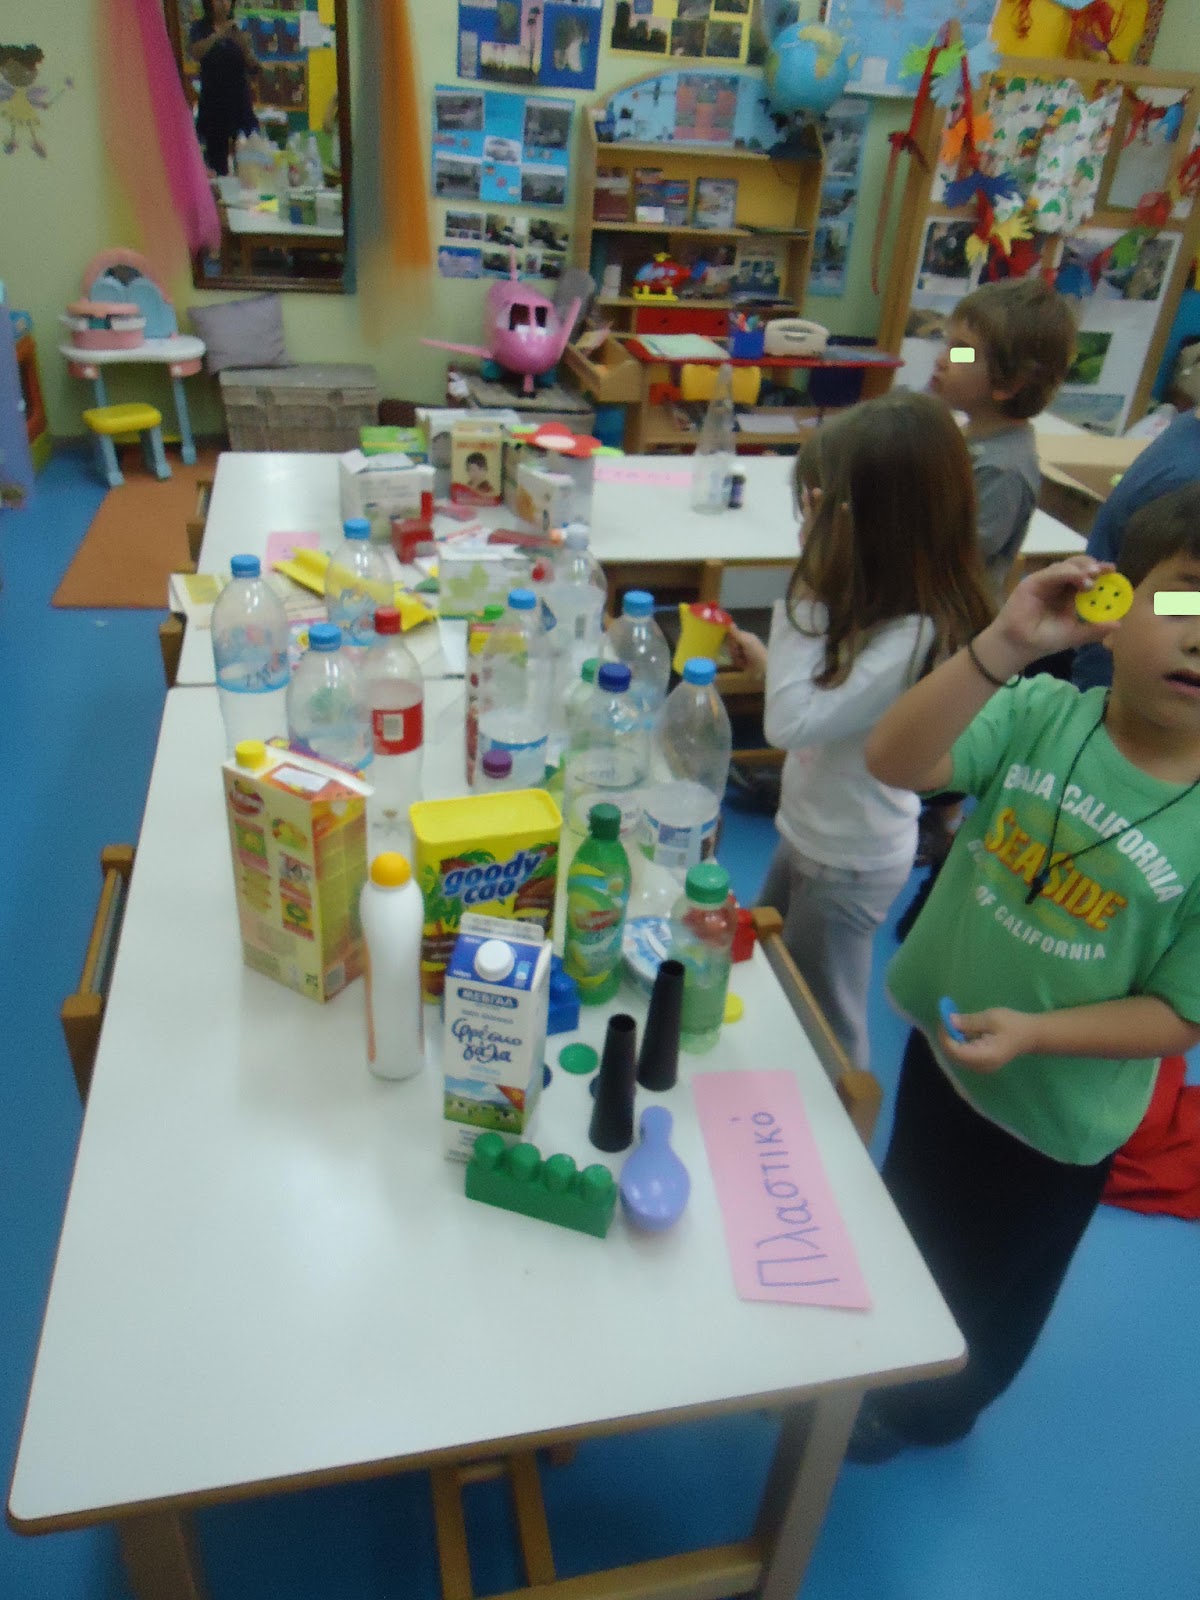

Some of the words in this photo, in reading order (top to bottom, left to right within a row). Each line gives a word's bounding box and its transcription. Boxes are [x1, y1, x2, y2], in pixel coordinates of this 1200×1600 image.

[444, 850, 543, 897] goody
[984, 807, 1129, 932] SEASIDE
[1059, 784, 1185, 904] CALIFORNIA
[463, 879, 516, 904] cao
[975, 885, 997, 907] OF
[994, 904, 1107, 960] CALIFORNIA
